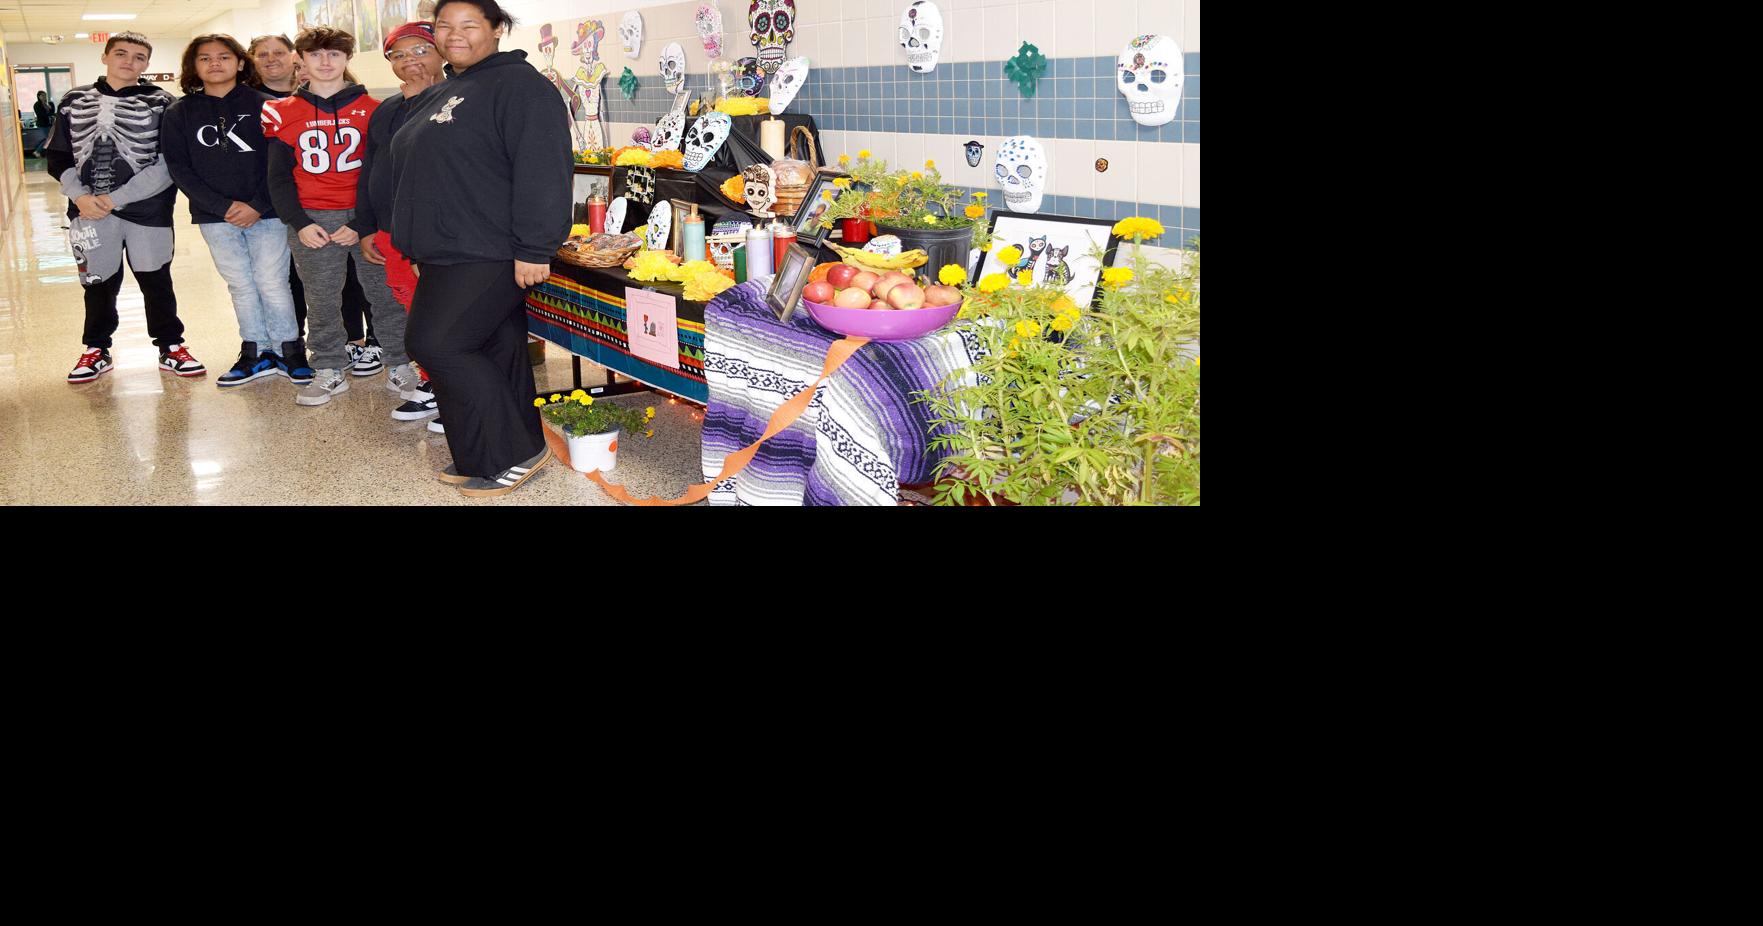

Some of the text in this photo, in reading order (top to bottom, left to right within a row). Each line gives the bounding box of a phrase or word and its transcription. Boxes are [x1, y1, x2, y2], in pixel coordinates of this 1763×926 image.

[92, 32, 109, 43] EXIT
[196, 114, 257, 152] CK
[305, 118, 351, 128] LUMBERJCKS
[298, 126, 363, 174] 82
